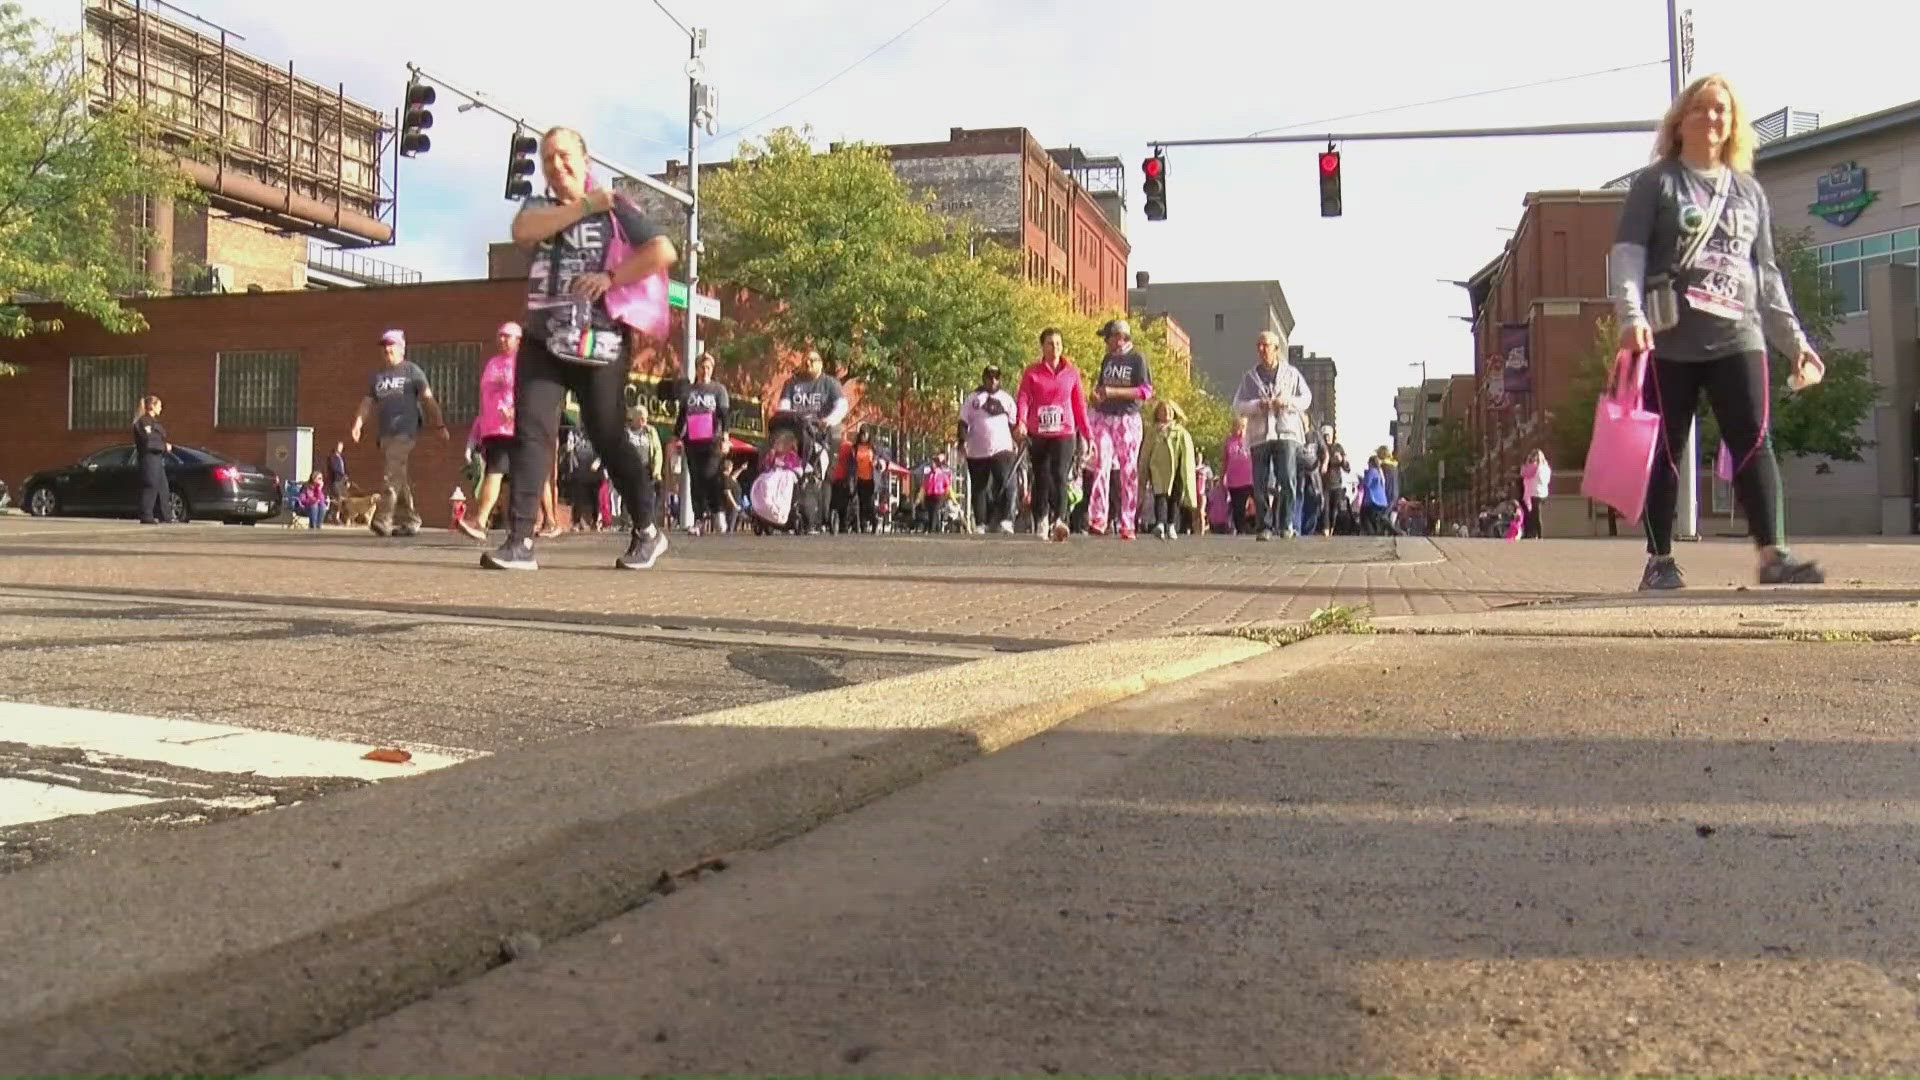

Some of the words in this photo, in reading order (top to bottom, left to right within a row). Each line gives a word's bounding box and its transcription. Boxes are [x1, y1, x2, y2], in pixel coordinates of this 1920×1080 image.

[1103, 363, 1133, 379] ONE
[376, 377, 406, 391] ONE
[793, 393, 821, 405] ONE
